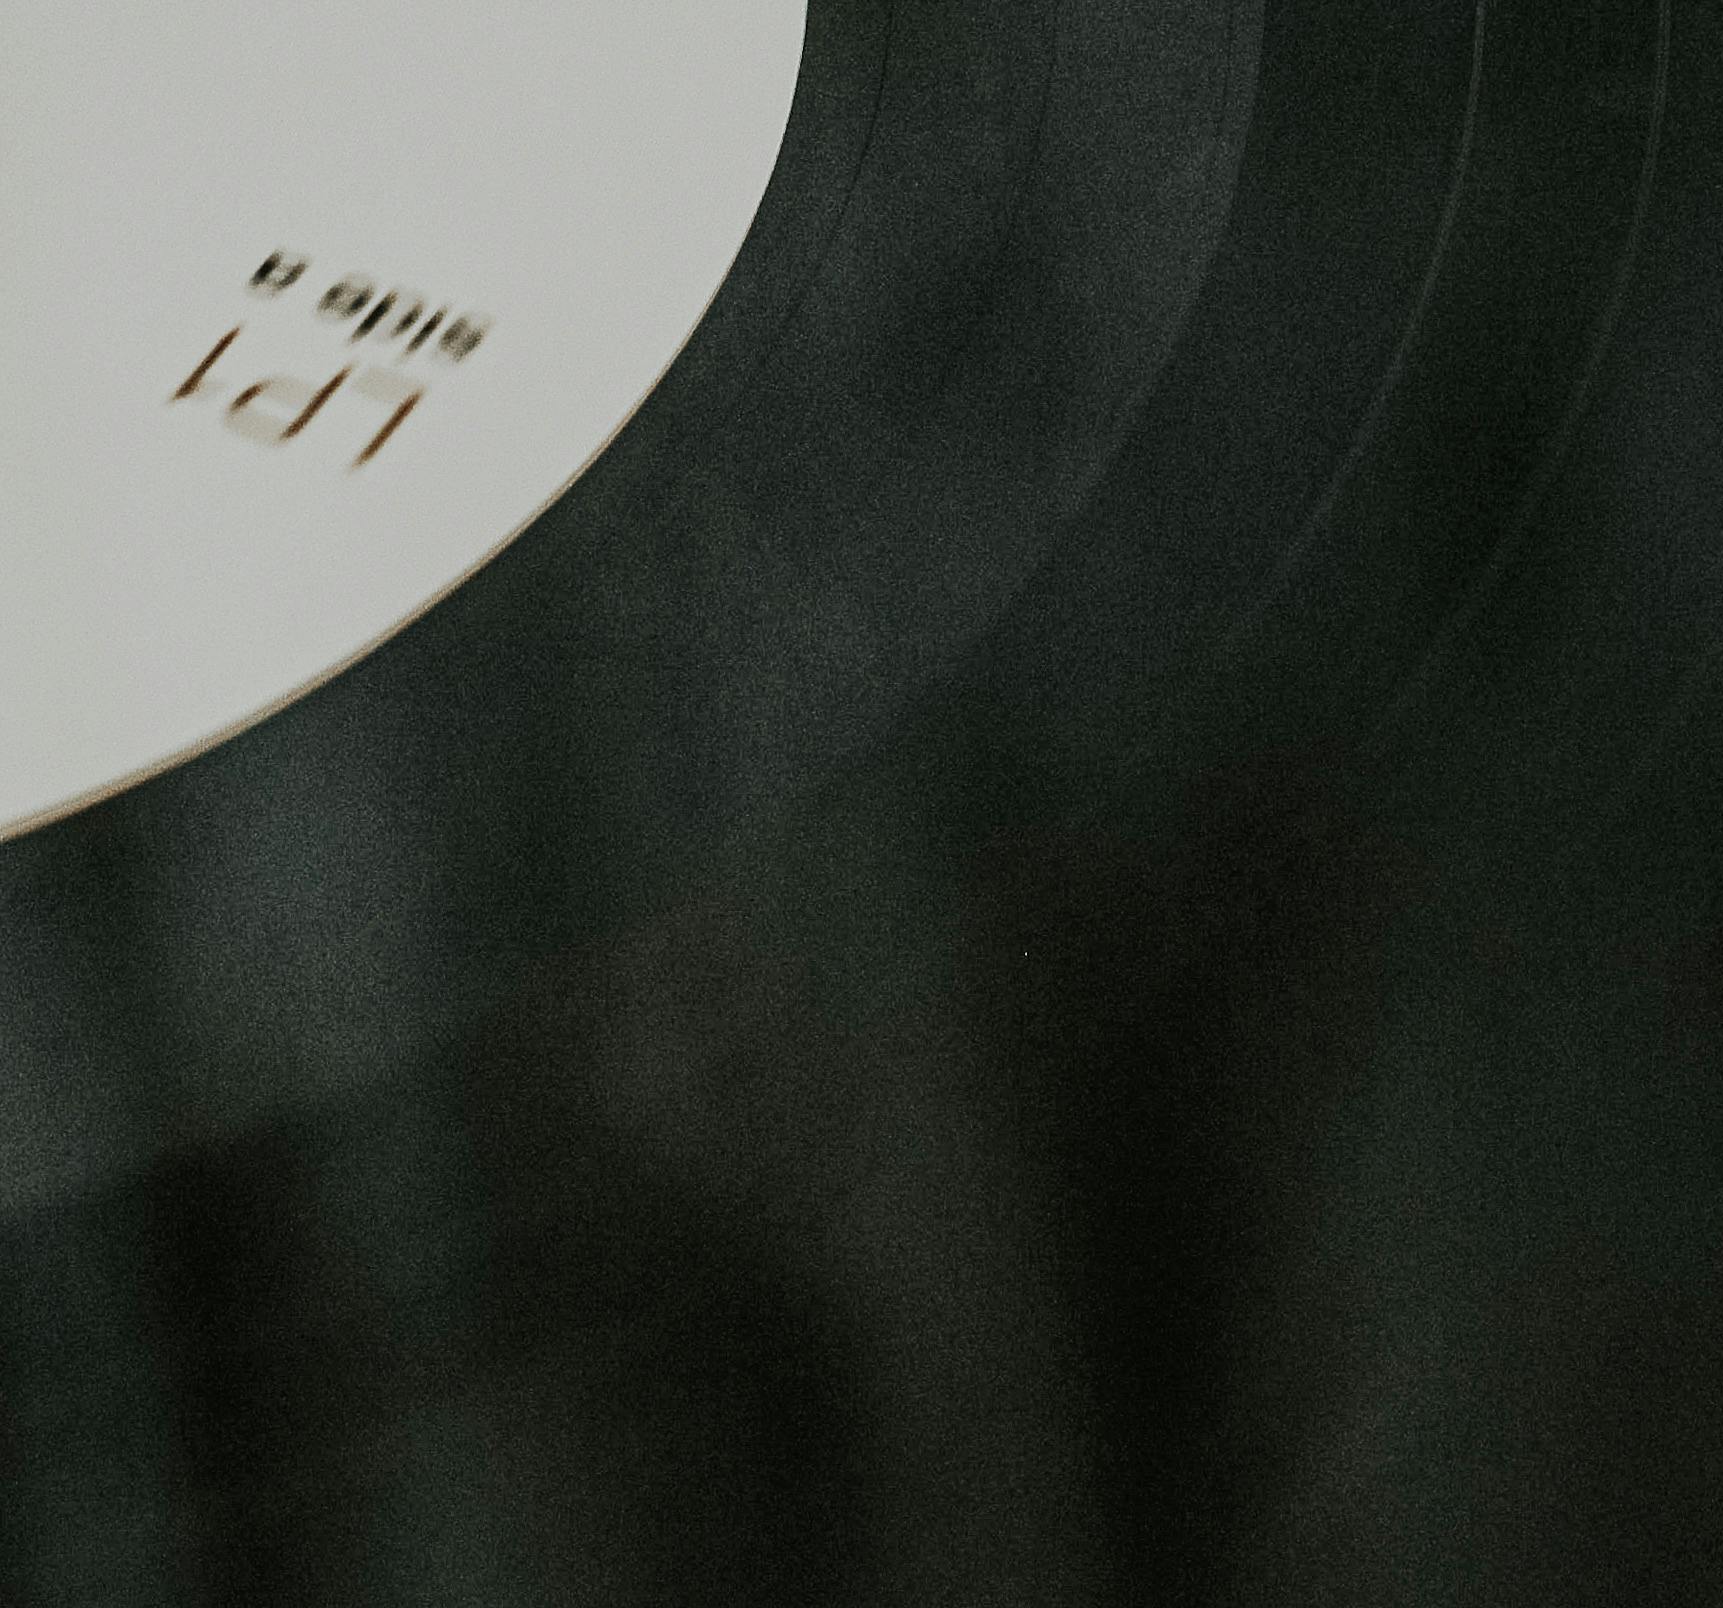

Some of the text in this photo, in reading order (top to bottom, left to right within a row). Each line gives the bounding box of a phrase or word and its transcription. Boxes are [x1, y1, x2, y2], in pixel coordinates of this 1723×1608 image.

[248, 249, 490, 360] side a
[167, 321, 424, 472] LP1
